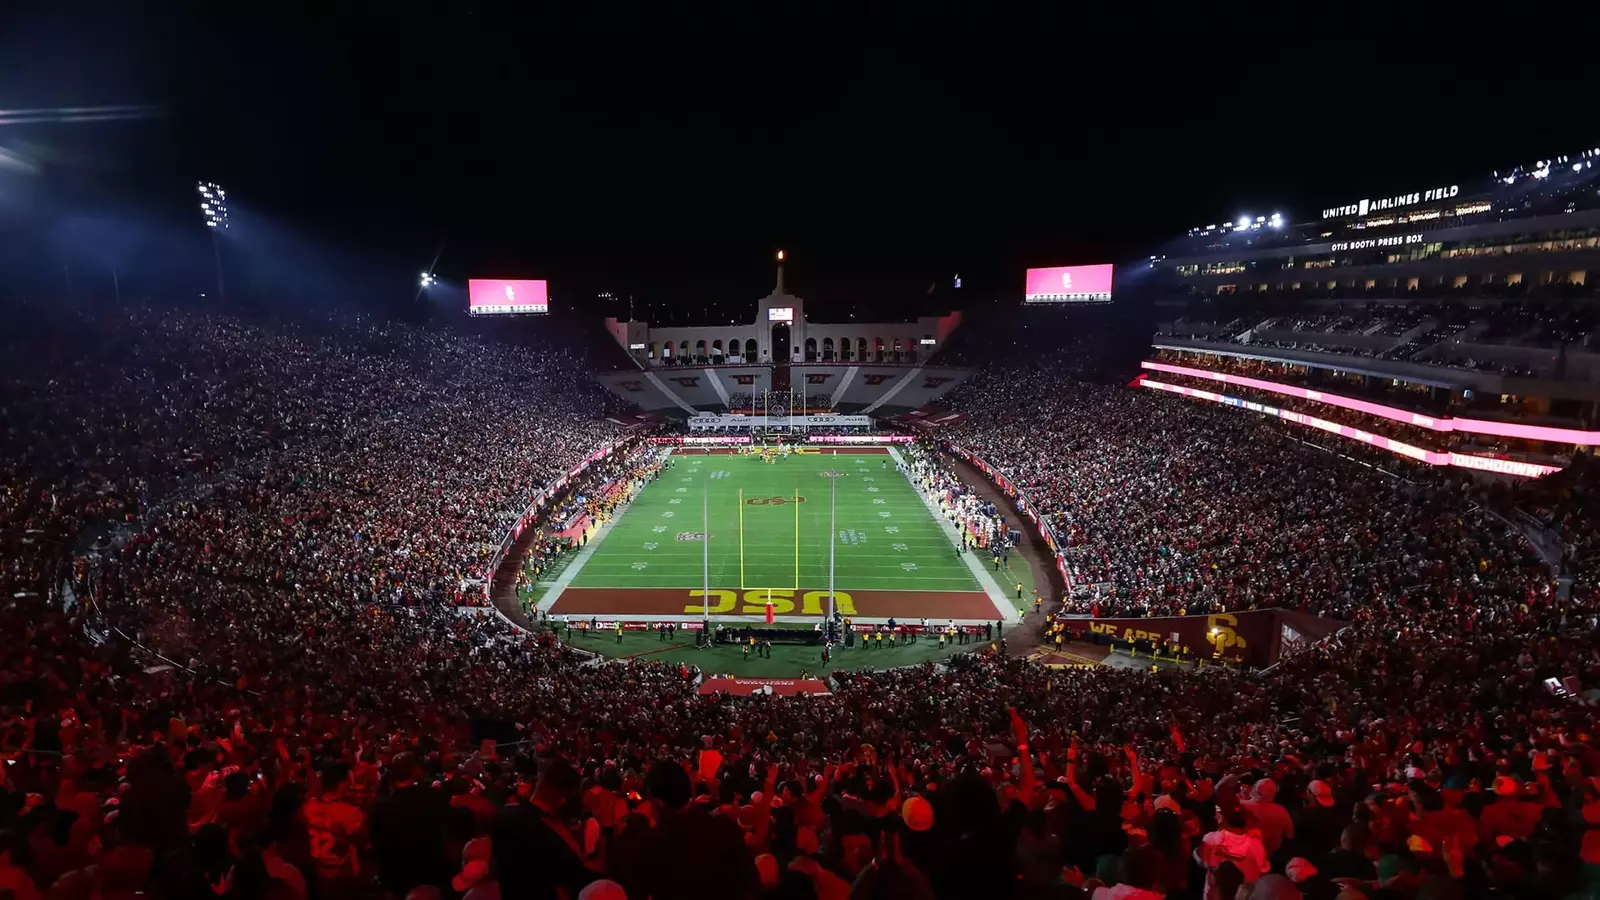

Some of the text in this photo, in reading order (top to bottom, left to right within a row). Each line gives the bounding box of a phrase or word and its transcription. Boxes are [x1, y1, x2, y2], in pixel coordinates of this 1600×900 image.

[1323, 185, 1459, 219] UNITED AIRLINES FIELD
[1331, 233, 1424, 252] OTIS BOOTH PRESS BOX
[683, 589, 858, 615] USC
[1089, 621, 1118, 635] WE
